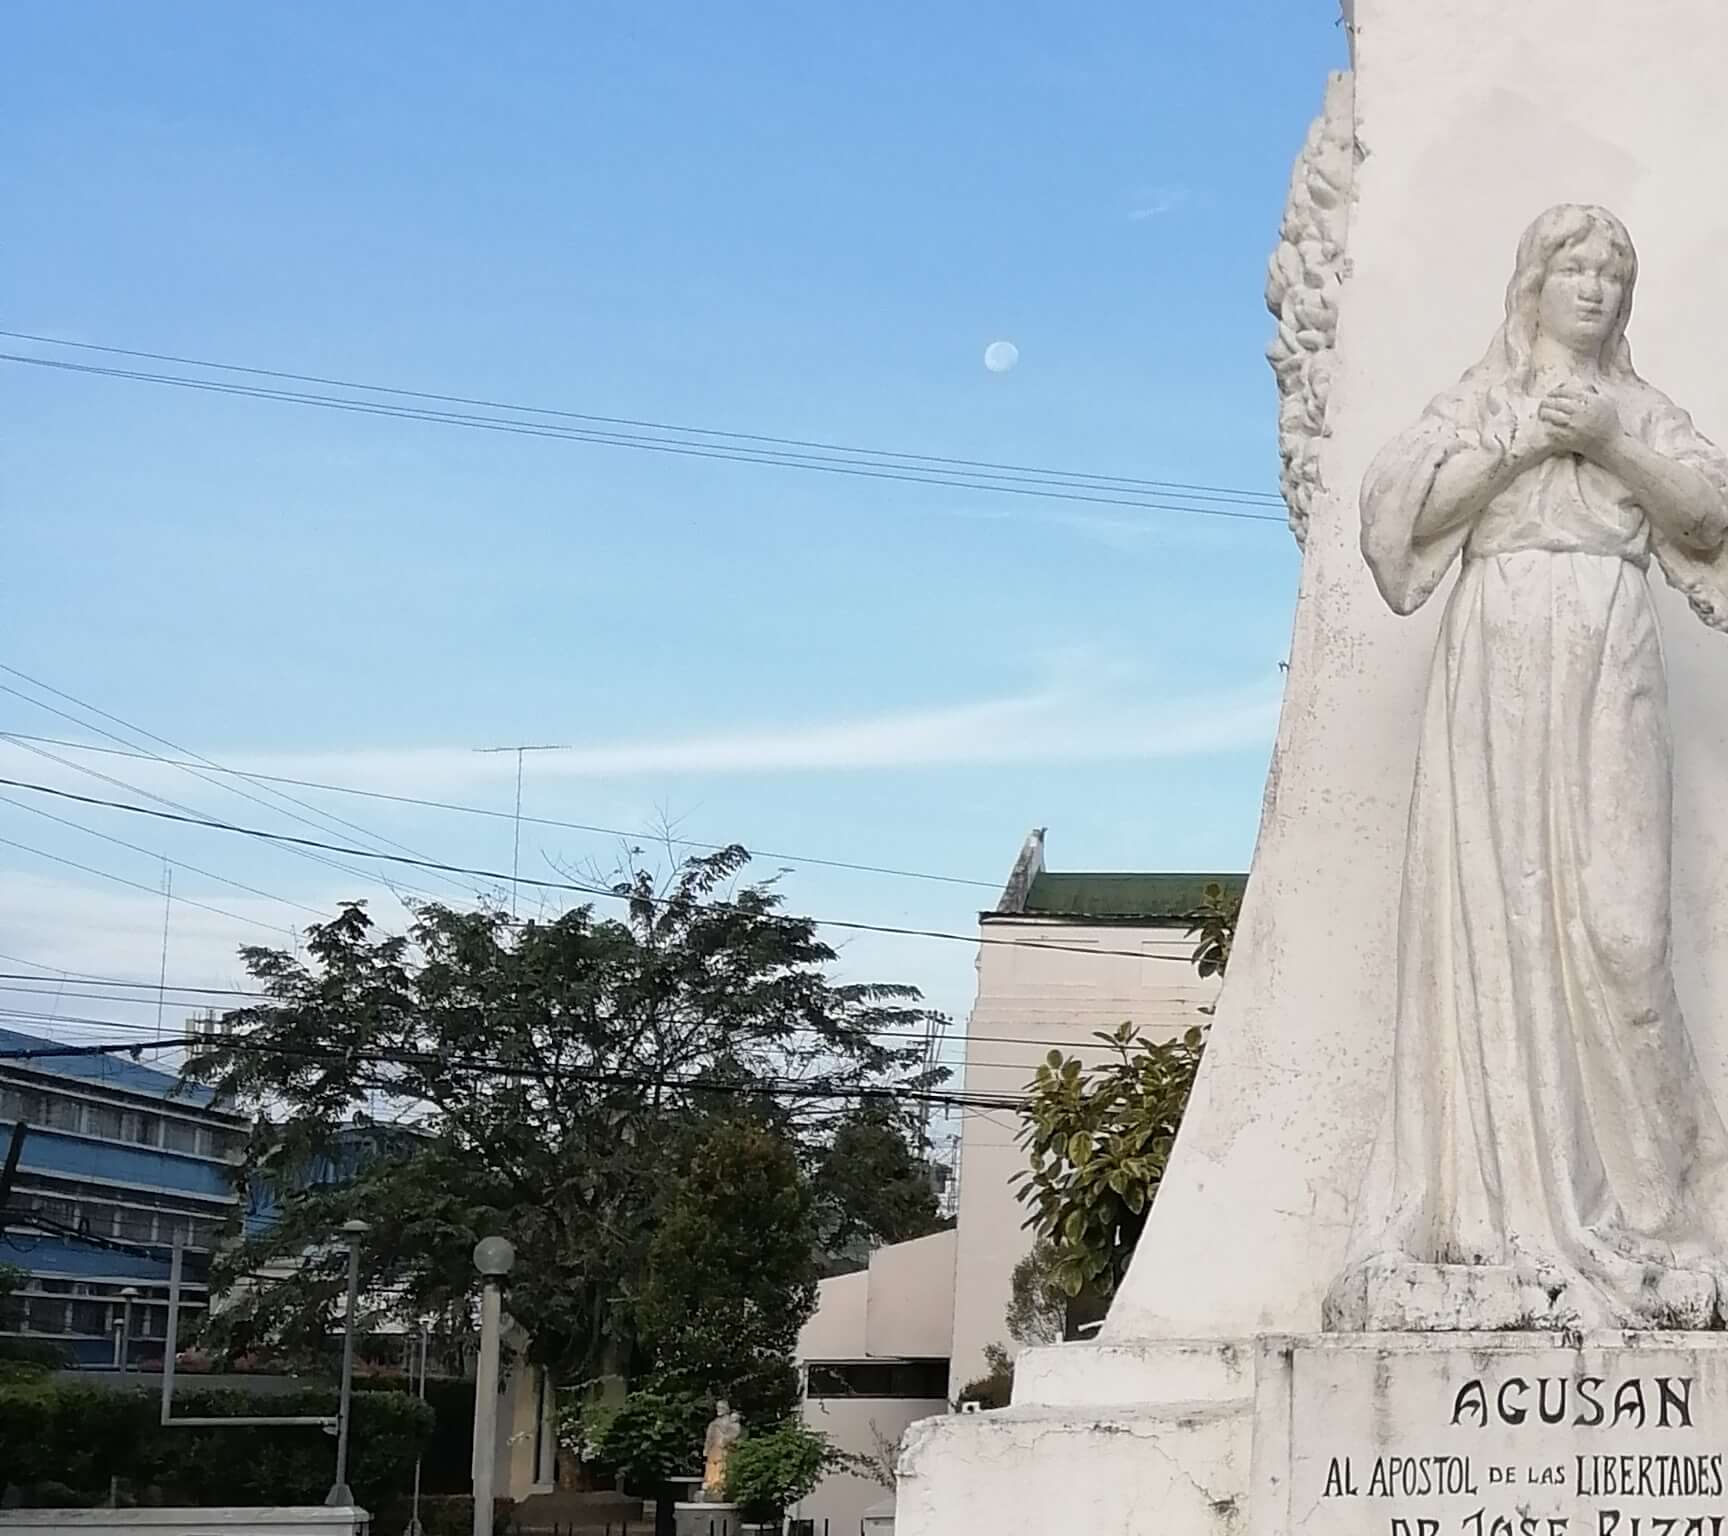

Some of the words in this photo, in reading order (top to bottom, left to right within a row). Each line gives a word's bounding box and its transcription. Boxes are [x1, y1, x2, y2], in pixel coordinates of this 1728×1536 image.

[1451, 1377, 1694, 1427] AGUSAN
[1323, 1456, 1359, 1496] AL
[1367, 1456, 1478, 1497] APOSTOL
[1489, 1466, 1516, 1484] DE
[1528, 1466, 1565, 1484] LAS
[1576, 1455, 1723, 1497] LIBERTADES
